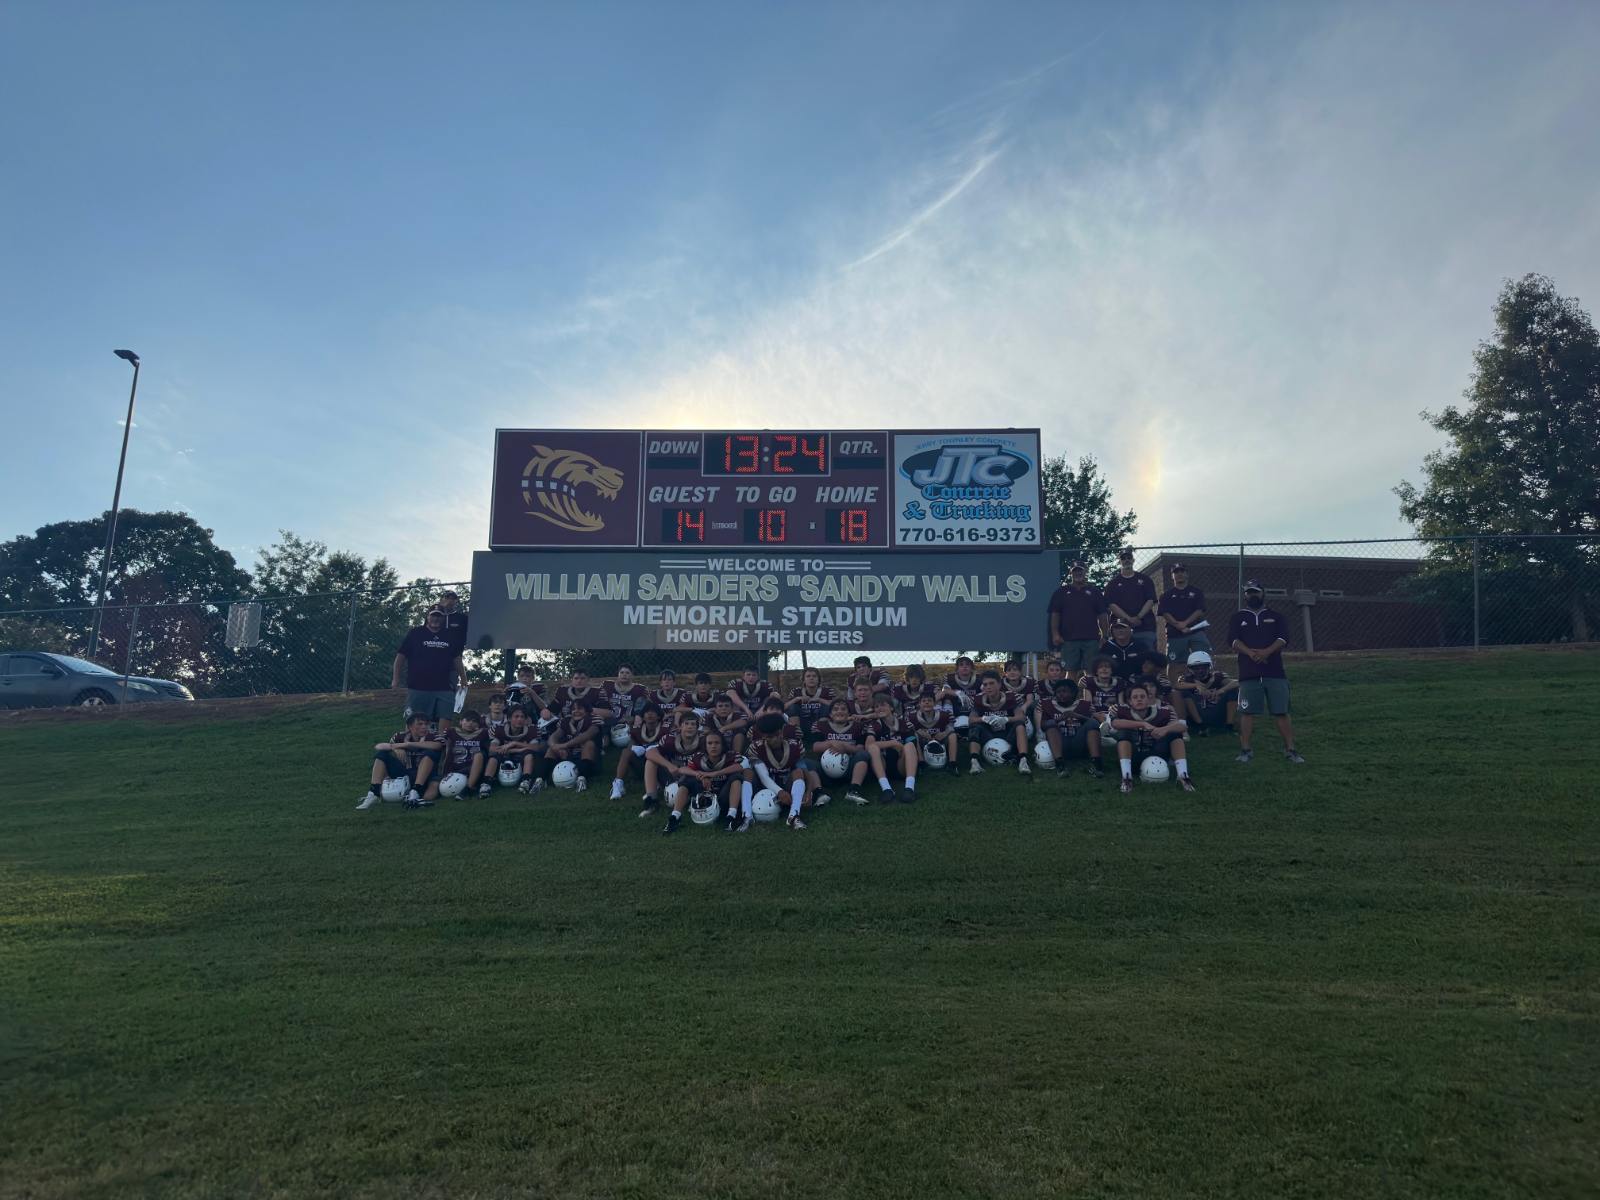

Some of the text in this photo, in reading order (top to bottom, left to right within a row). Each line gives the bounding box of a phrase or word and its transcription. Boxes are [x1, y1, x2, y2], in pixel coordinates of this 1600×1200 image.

[649, 440, 699, 454] DOWN
[839, 440, 879, 454] QTR.
[914, 437, 1017, 451] JERRY TOWNLEY CONCRETE
[725, 435, 825, 472] 13:24
[913, 446, 1019, 487] JTC
[648, 486, 720, 503] GUEST
[735, 486, 797, 503] TO GO
[815, 486, 879, 503] HOME
[921, 484, 1012, 501] Concrete
[902, 500, 1032, 523] & Trucking
[677, 510, 704, 542] 14
[758, 510, 786, 542] 10
[840, 510, 867, 542] 18
[899, 527, 1036, 542] 770-616-9373
[707, 558, 825, 572] WELCOME TO
[505, 573, 1027, 603] WILLIAM SANDERS "SANDY" WALLS
[623, 605, 907, 627] MEMORIAL STADIUM
[666, 629, 864, 645] HOME OF THE TIGERS
